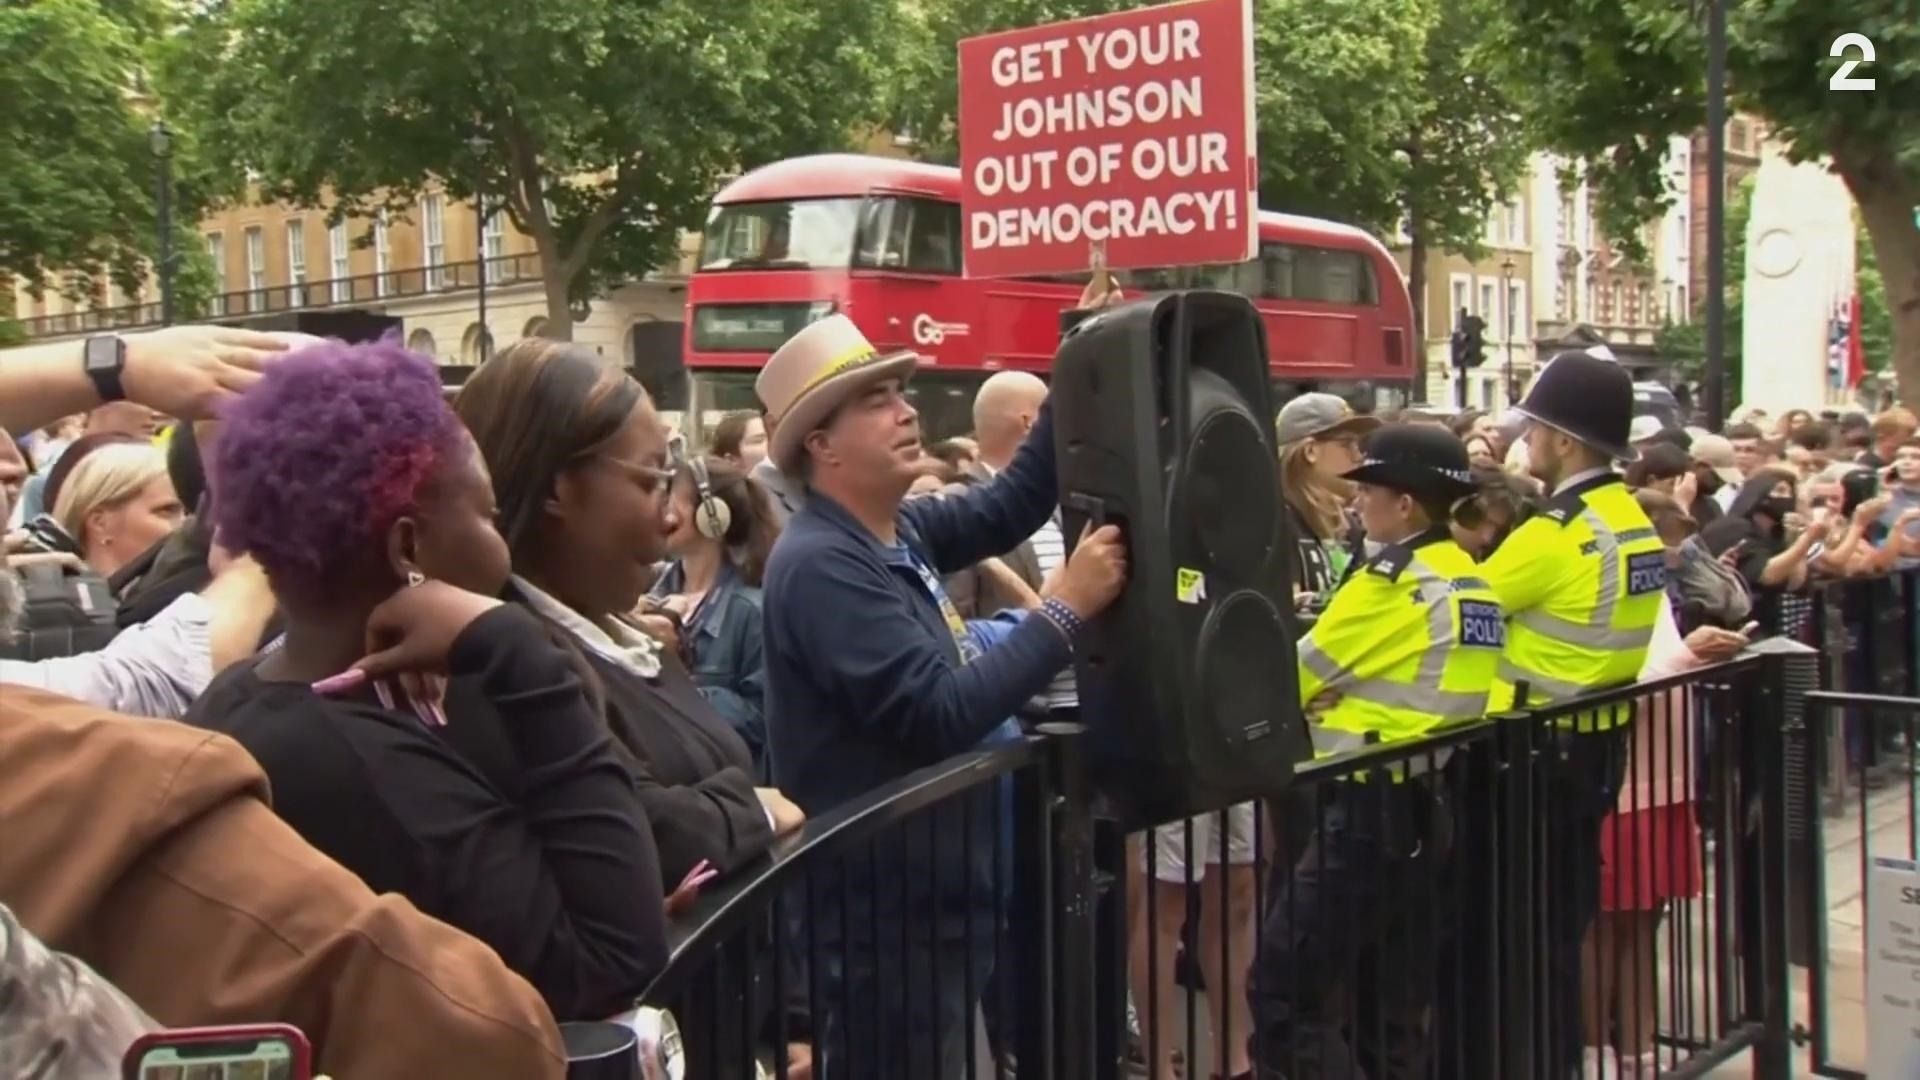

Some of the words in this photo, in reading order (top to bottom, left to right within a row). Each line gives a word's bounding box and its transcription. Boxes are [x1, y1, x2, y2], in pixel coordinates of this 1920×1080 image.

[991, 38, 1069, 87] GET
[1077, 19, 1201, 74] YOUR
[992, 76, 1203, 142] JOHNSON
[974, 150, 1059, 197] OUT
[1066, 143, 1123, 188] OF
[1131, 132, 1230, 180] OUR
[971, 189, 1237, 250] DEMOCRACY!
